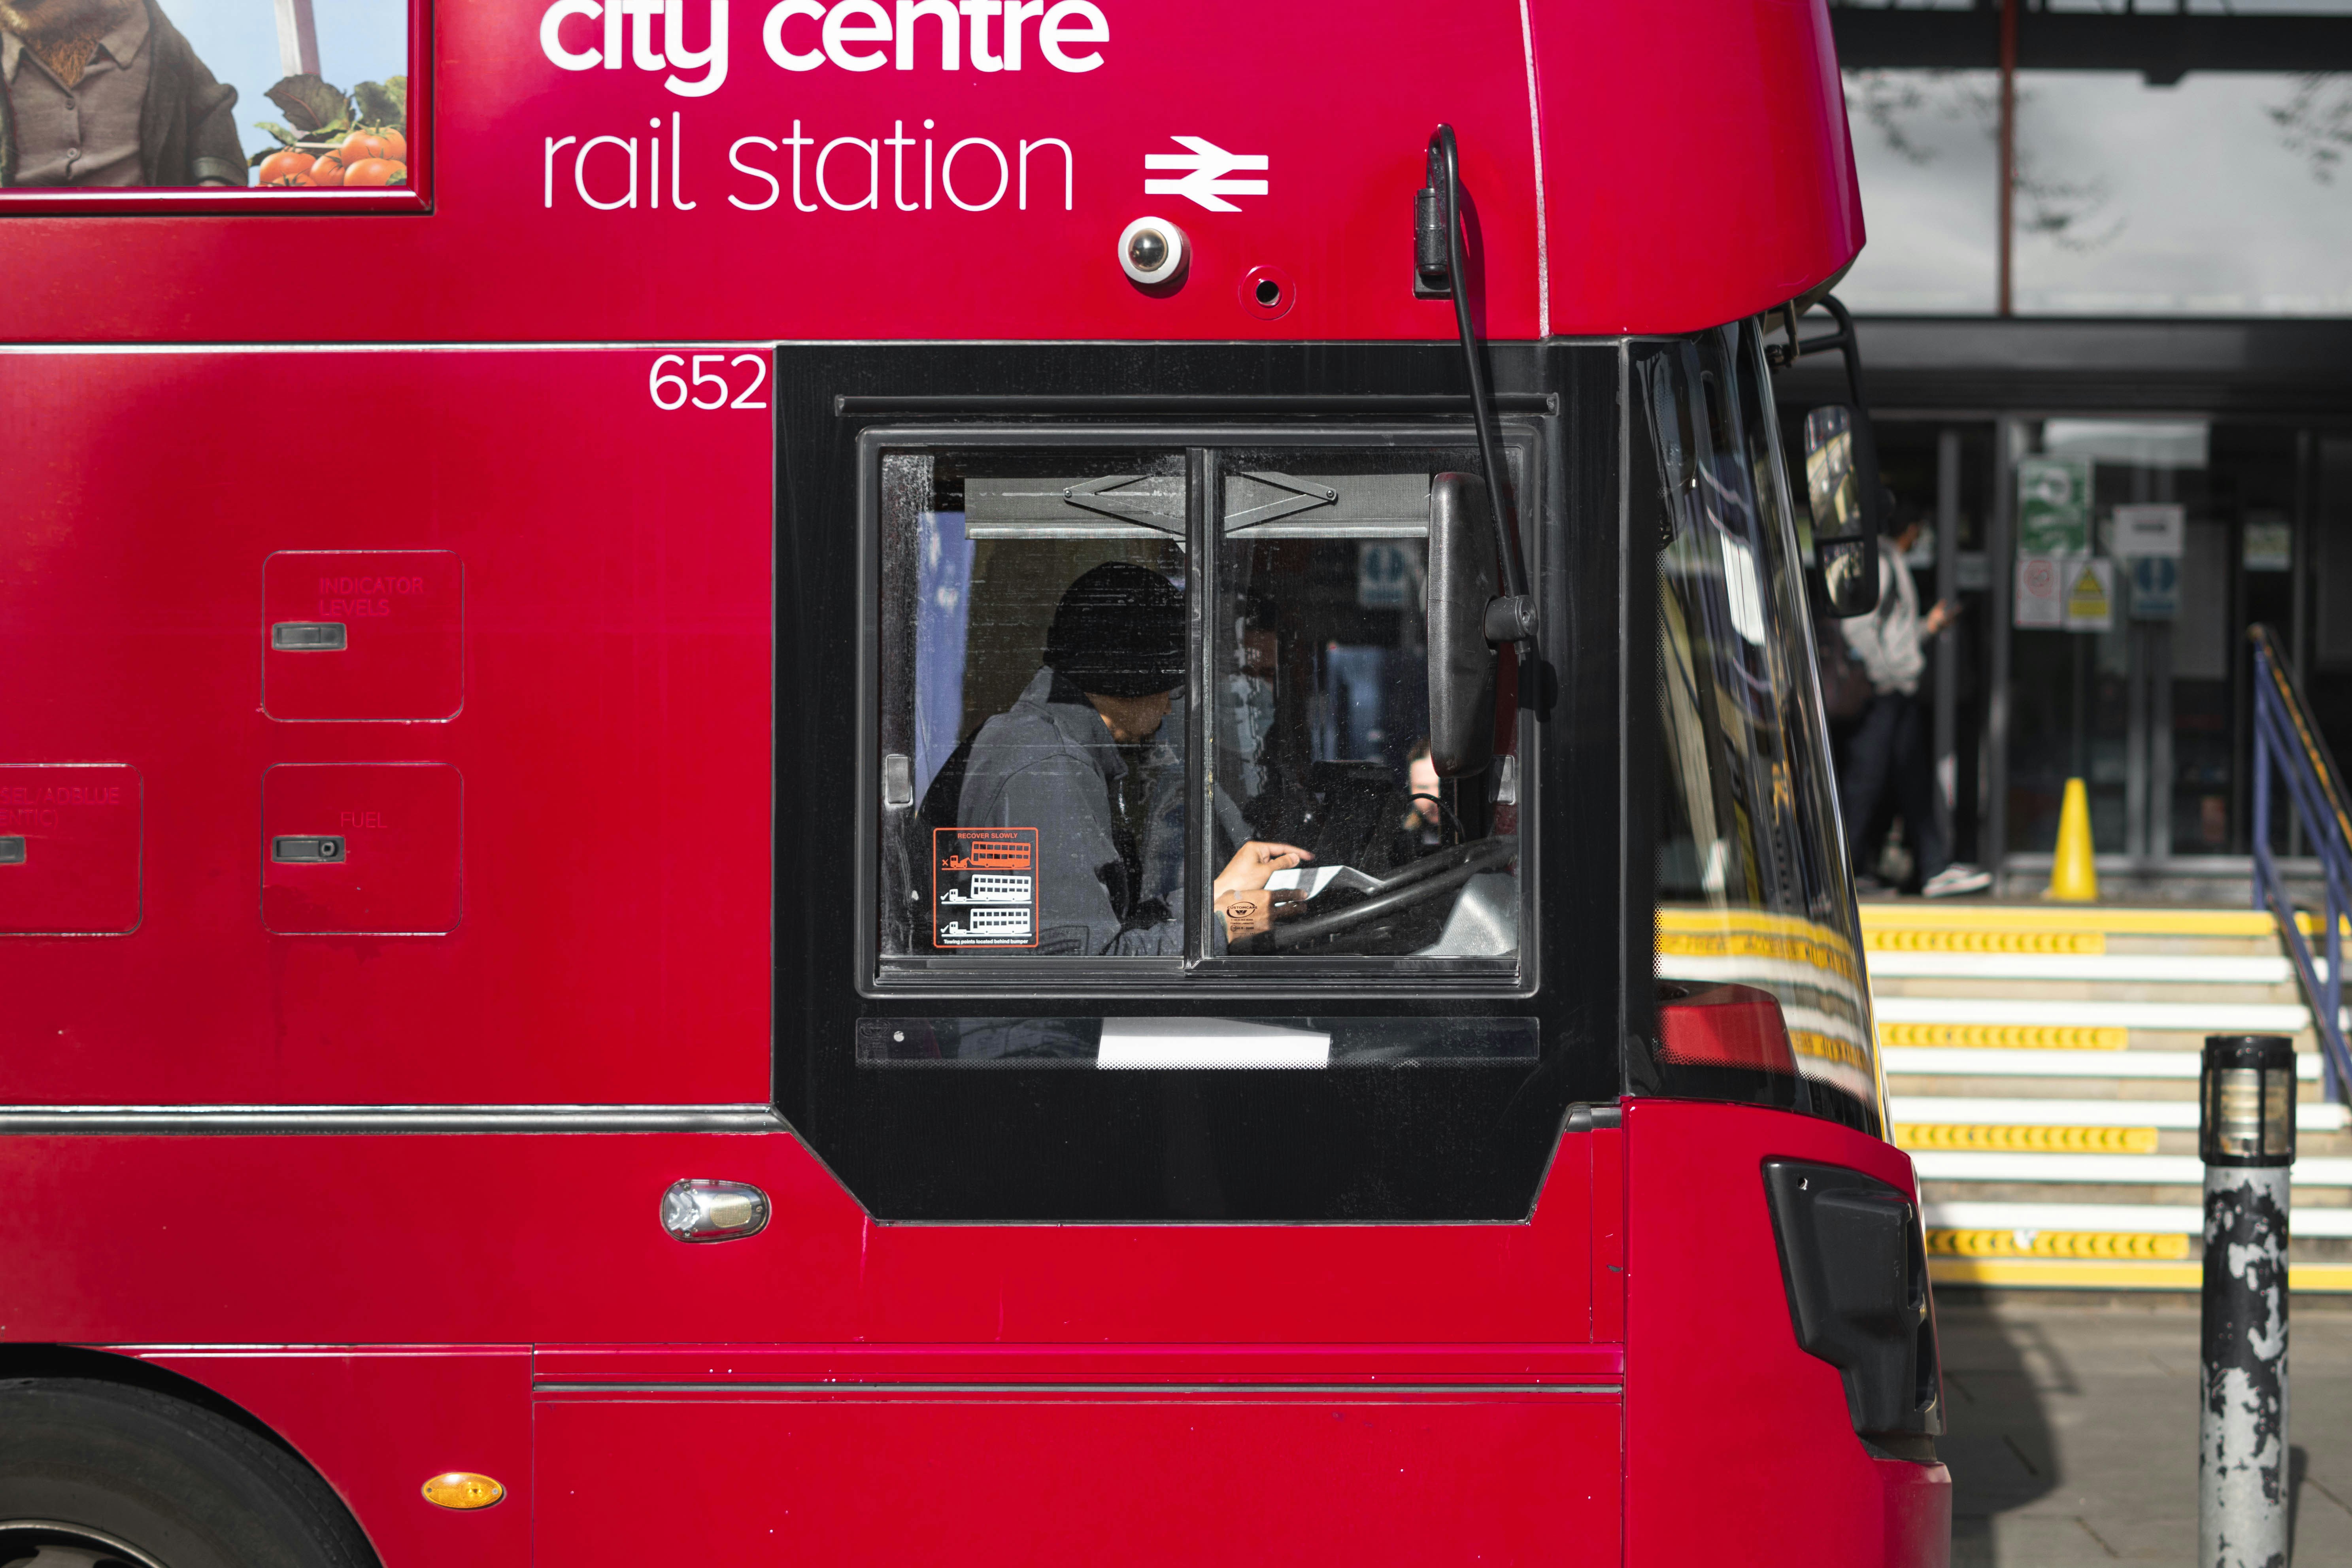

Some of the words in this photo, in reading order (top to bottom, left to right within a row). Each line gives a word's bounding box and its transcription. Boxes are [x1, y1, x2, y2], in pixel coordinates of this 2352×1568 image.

[540, 0, 728, 97] city
[763, 0, 1110, 73] centre
[545, 112, 696, 210] rail
[729, 119, 1072, 212] station
[650, 355, 766, 410] 652
[320, 577, 423, 593] INDICATOR
[320, 600, 390, 615] LEVELS
[341, 811, 387, 828] FUEL
